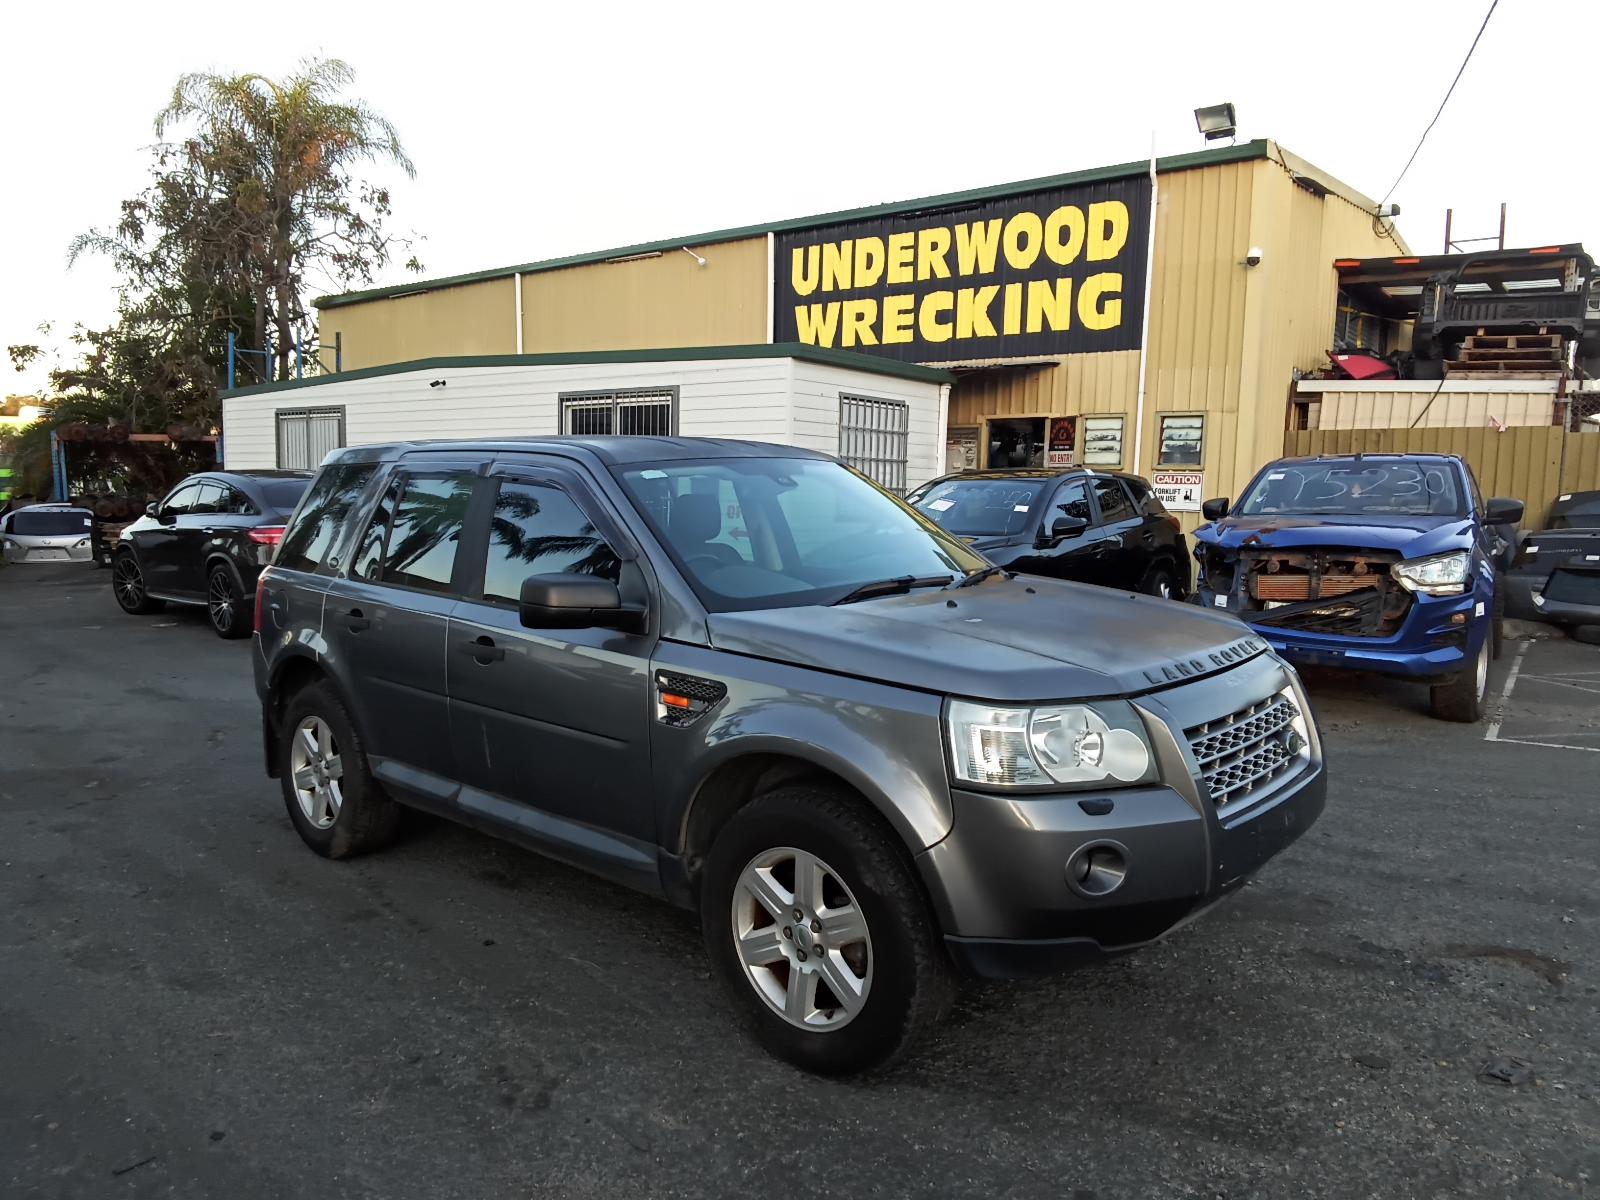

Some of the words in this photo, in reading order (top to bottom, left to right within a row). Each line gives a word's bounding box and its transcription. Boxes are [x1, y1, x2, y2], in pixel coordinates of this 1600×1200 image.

[792, 200, 1129, 296] UNDERWOOD
[795, 272, 1123, 348] WRECKING
[1057, 453, 1073, 463] ENTRY
[1154, 487, 1181, 495] FORKLIFT
[1156, 475, 1200, 484] CAUTION
[1142, 659, 1206, 685] LAND
[1207, 639, 1260, 667] ROVER
